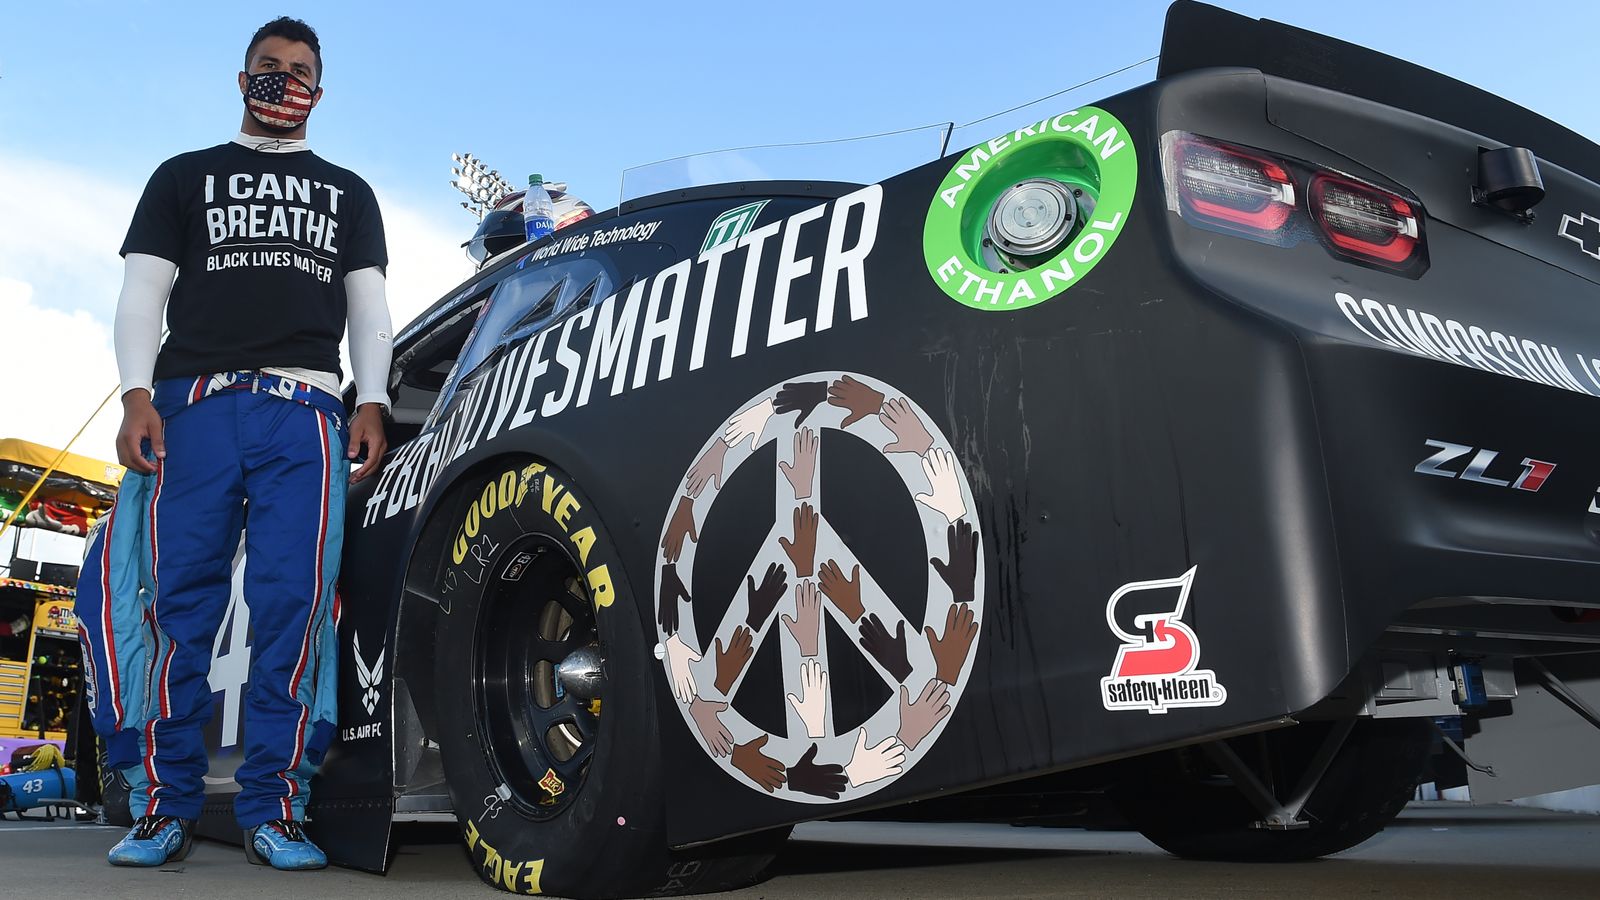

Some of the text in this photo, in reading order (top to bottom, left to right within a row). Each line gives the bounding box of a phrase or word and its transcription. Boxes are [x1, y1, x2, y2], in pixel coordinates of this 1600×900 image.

[940, 110, 1126, 208] AMERICAN
[205, 173, 344, 215] I CAN'T
[206, 204, 339, 254] BREATHE
[531, 220, 663, 262] World Wide Technology
[206, 252, 249, 271] BLACK
[252, 251, 291, 267] LIVES
[937, 212, 1122, 305] ETHANOL
[1414, 438, 1558, 492] ZL1
[452, 465, 616, 613] GOODYEAR
[342, 727, 356, 742] U.S.
[357, 723, 371, 739] AIR
[22, 778, 43, 794] 43
[464, 818, 545, 895] EAGLE
